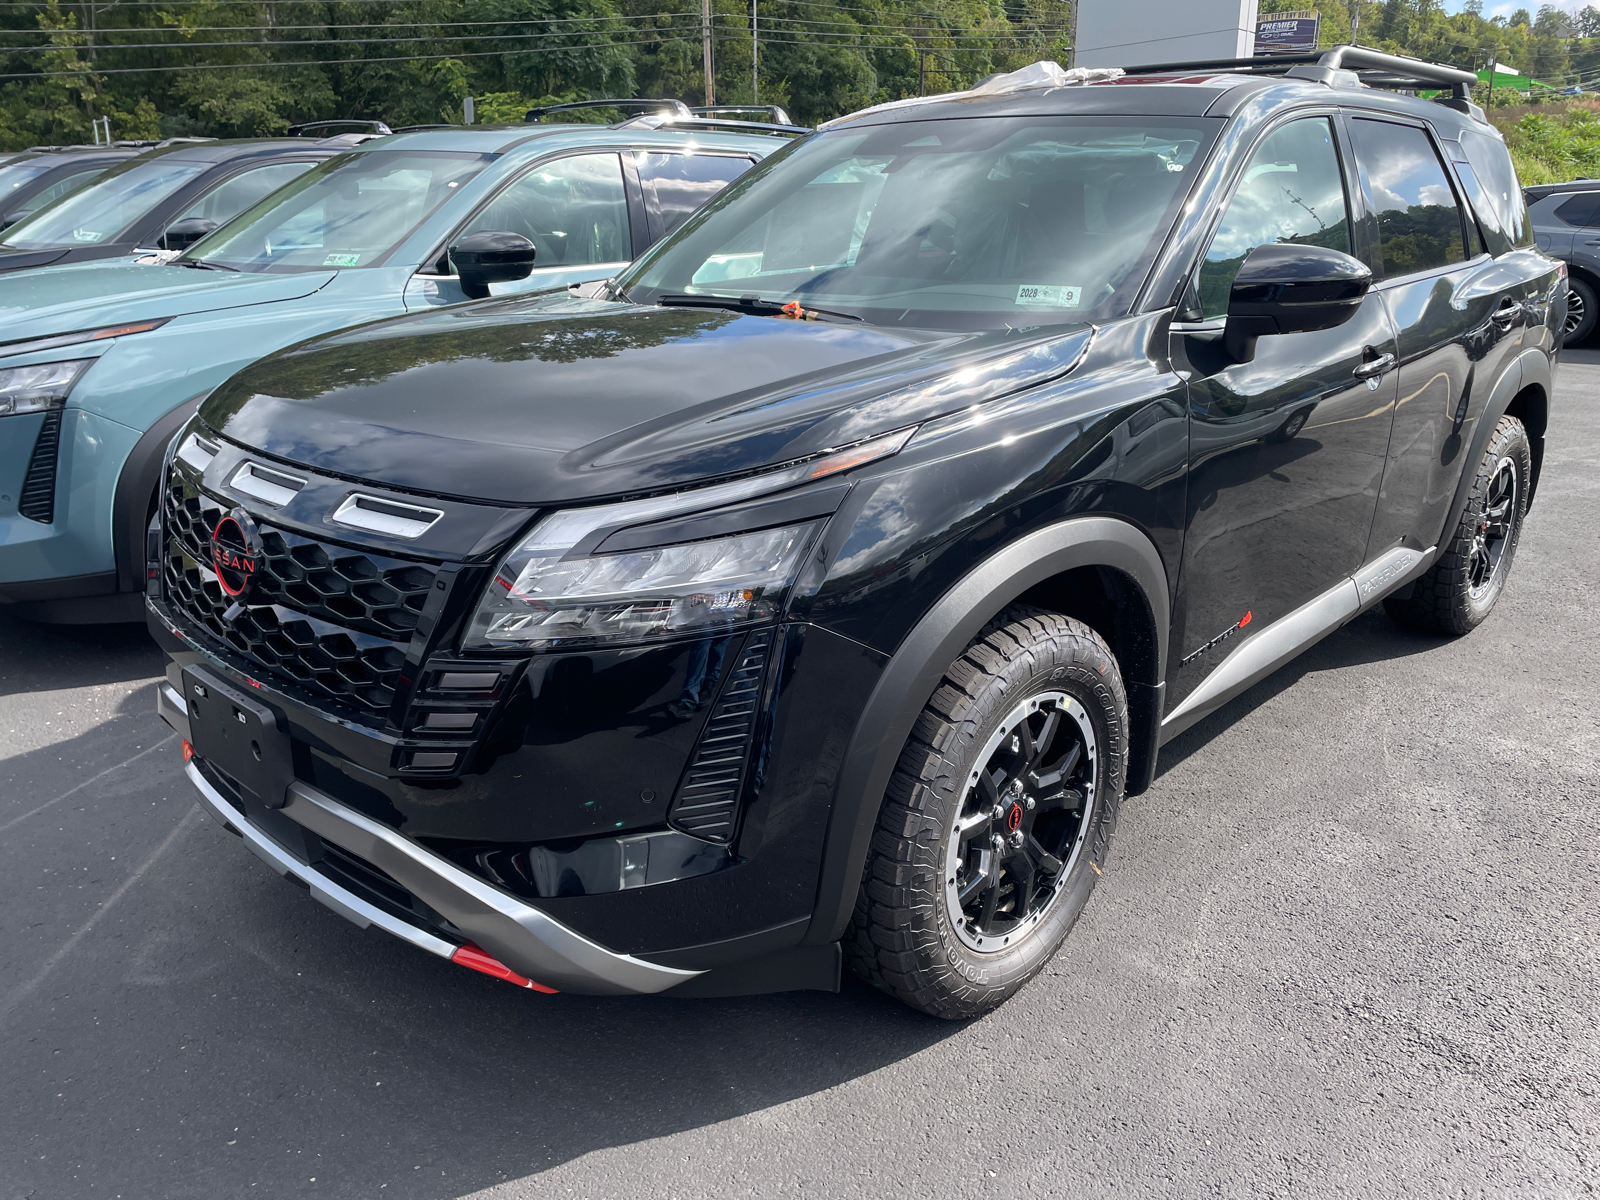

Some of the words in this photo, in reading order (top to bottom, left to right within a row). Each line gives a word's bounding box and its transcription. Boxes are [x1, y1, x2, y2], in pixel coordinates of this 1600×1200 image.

[1260, 21, 1298, 31] PREMIER
[1020, 287, 1038, 298] 2028
[1066, 291, 1074, 301] 9
[215, 548, 255, 573] SSAN
[1360, 553, 1413, 595] PATHFINDER
[1050, 666, 1098, 688] OPEN
[1093, 683, 1120, 791] COUNTRY
[1093, 799, 1114, 862] A/T
[947, 945, 988, 986] TOYO
